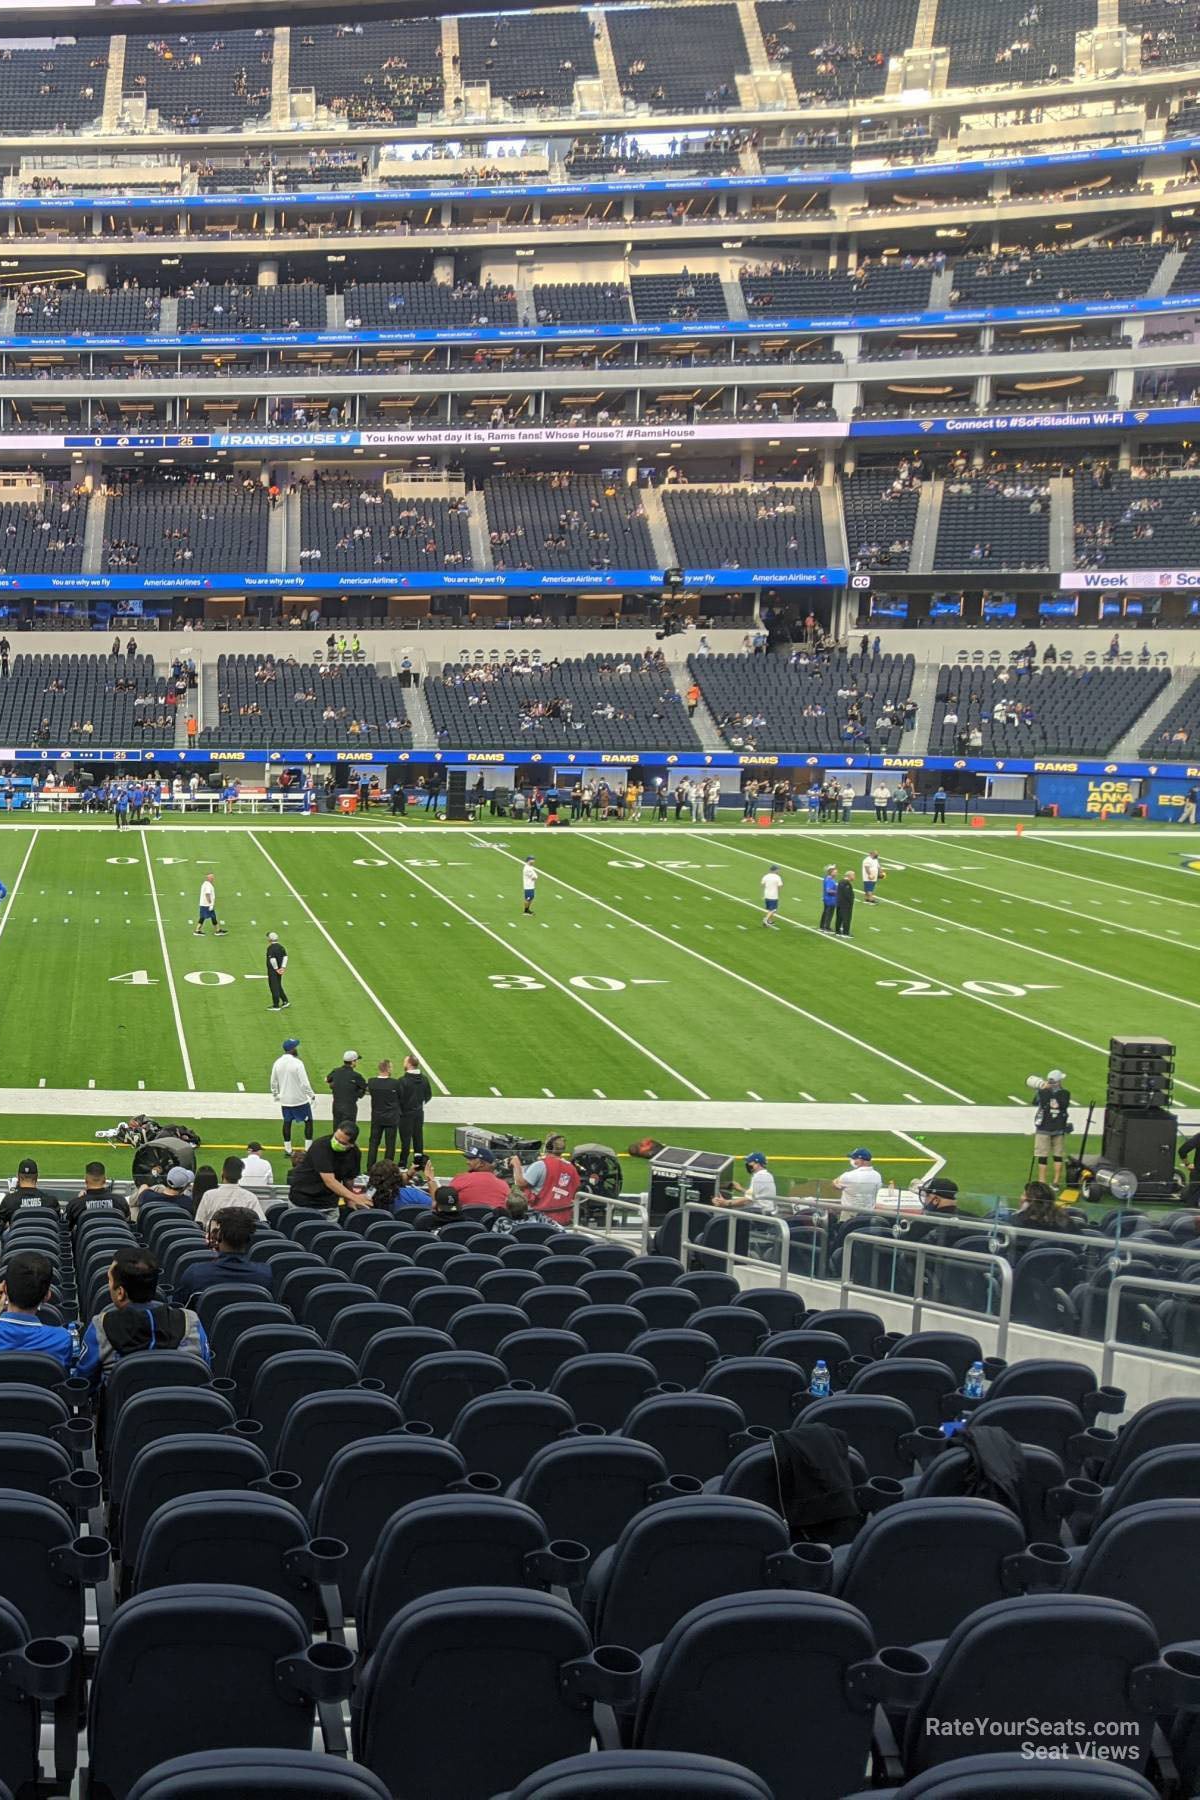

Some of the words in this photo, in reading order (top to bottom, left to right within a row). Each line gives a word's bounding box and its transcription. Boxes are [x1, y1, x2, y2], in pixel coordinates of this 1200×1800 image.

[946, 419, 997, 430] Connect
[999, 420, 1007, 429] to
[1010, 416, 1090, 428] #SoFiStadium
[1093, 414, 1123, 425] Wi-Fi
[220, 434, 336, 445] #RAMSHOUSE
[366, 434, 386, 443] You
[387, 434, 416, 442] know
[417, 433, 442, 442] what
[444, 433, 462, 444] day
[464, 432, 472, 441] it
[474, 432, 485, 443] is,
[488, 432, 516, 441] Rams
[518, 431, 543, 440] fans!
[545, 430, 580, 440] Whose
[582, 430, 624, 439] House?!
[626, 428, 695, 438] #RamsHouse
[94, 437, 102, 446] 0
[76, 579, 90, 587] why
[269, 578, 284, 586] why
[469, 576, 484, 585] why
[854, 578, 869, 587] CC
[1084, 574, 1128, 586] Week
[41, 750, 48, 759] 0
[210, 752, 245, 760] RAMS
[337, 752, 373, 761] RAMS
[467, 753, 504, 761] RAMS
[601, 754, 640, 763] RAMS
[739, 755, 779, 765] RAMS
[883, 758, 924, 768] RAMS
[1034, 762, 1078, 772] RAMS
[1088, 781, 1129, 792] LOS
[108, 970, 236, 986] 40
[487, 974, 627, 991] 30
[875, 979, 1028, 997] 20
[652, 1170, 677, 1178] FIELD
[20, 1197, 42, 1208] JACOBS
